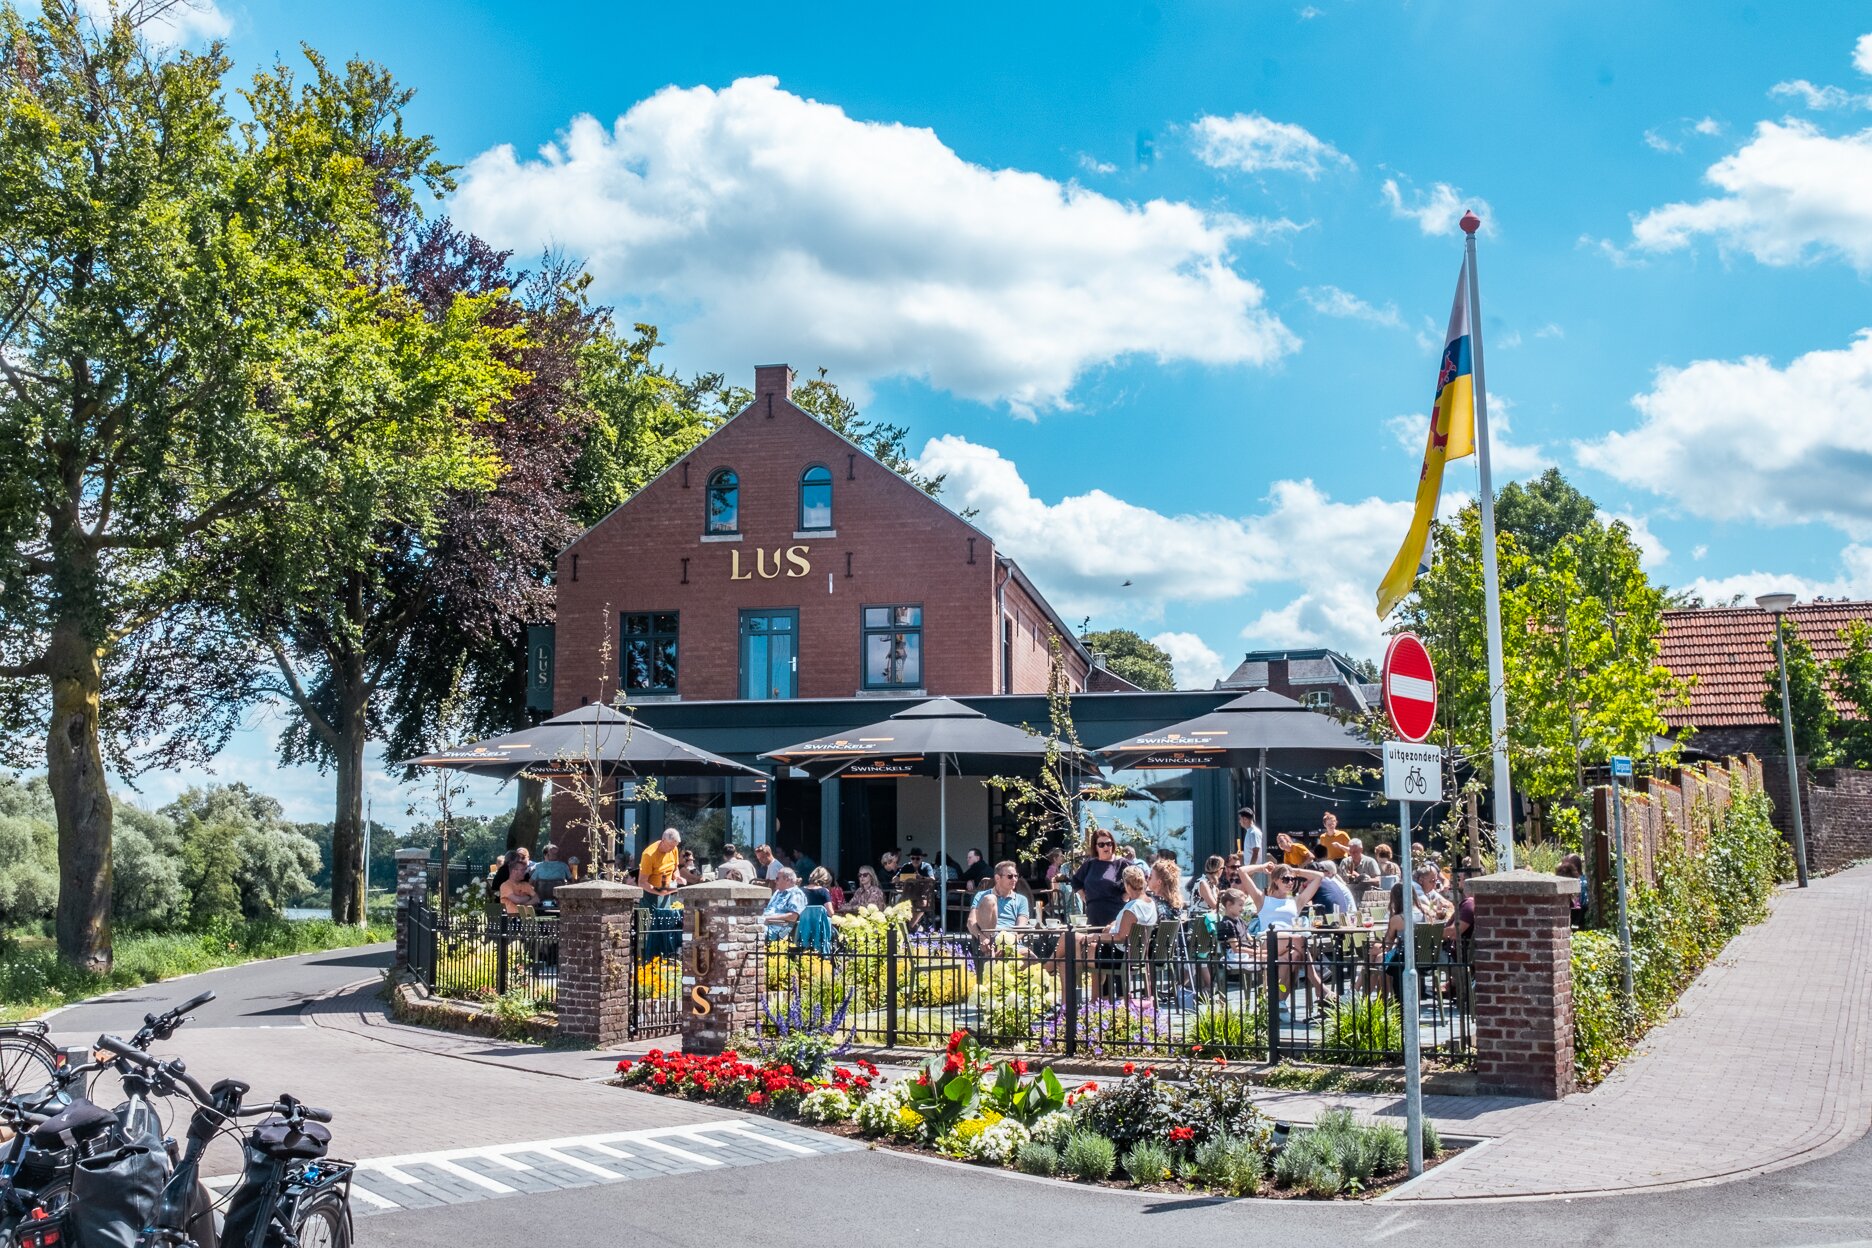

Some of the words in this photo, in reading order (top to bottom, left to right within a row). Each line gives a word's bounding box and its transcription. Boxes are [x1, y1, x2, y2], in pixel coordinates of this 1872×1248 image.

[730, 545, 811, 580] LUS
[538, 647, 548, 684] LUS
[1388, 748, 1440, 763] uitgezonderd
[691, 909, 711, 1016] LUS
